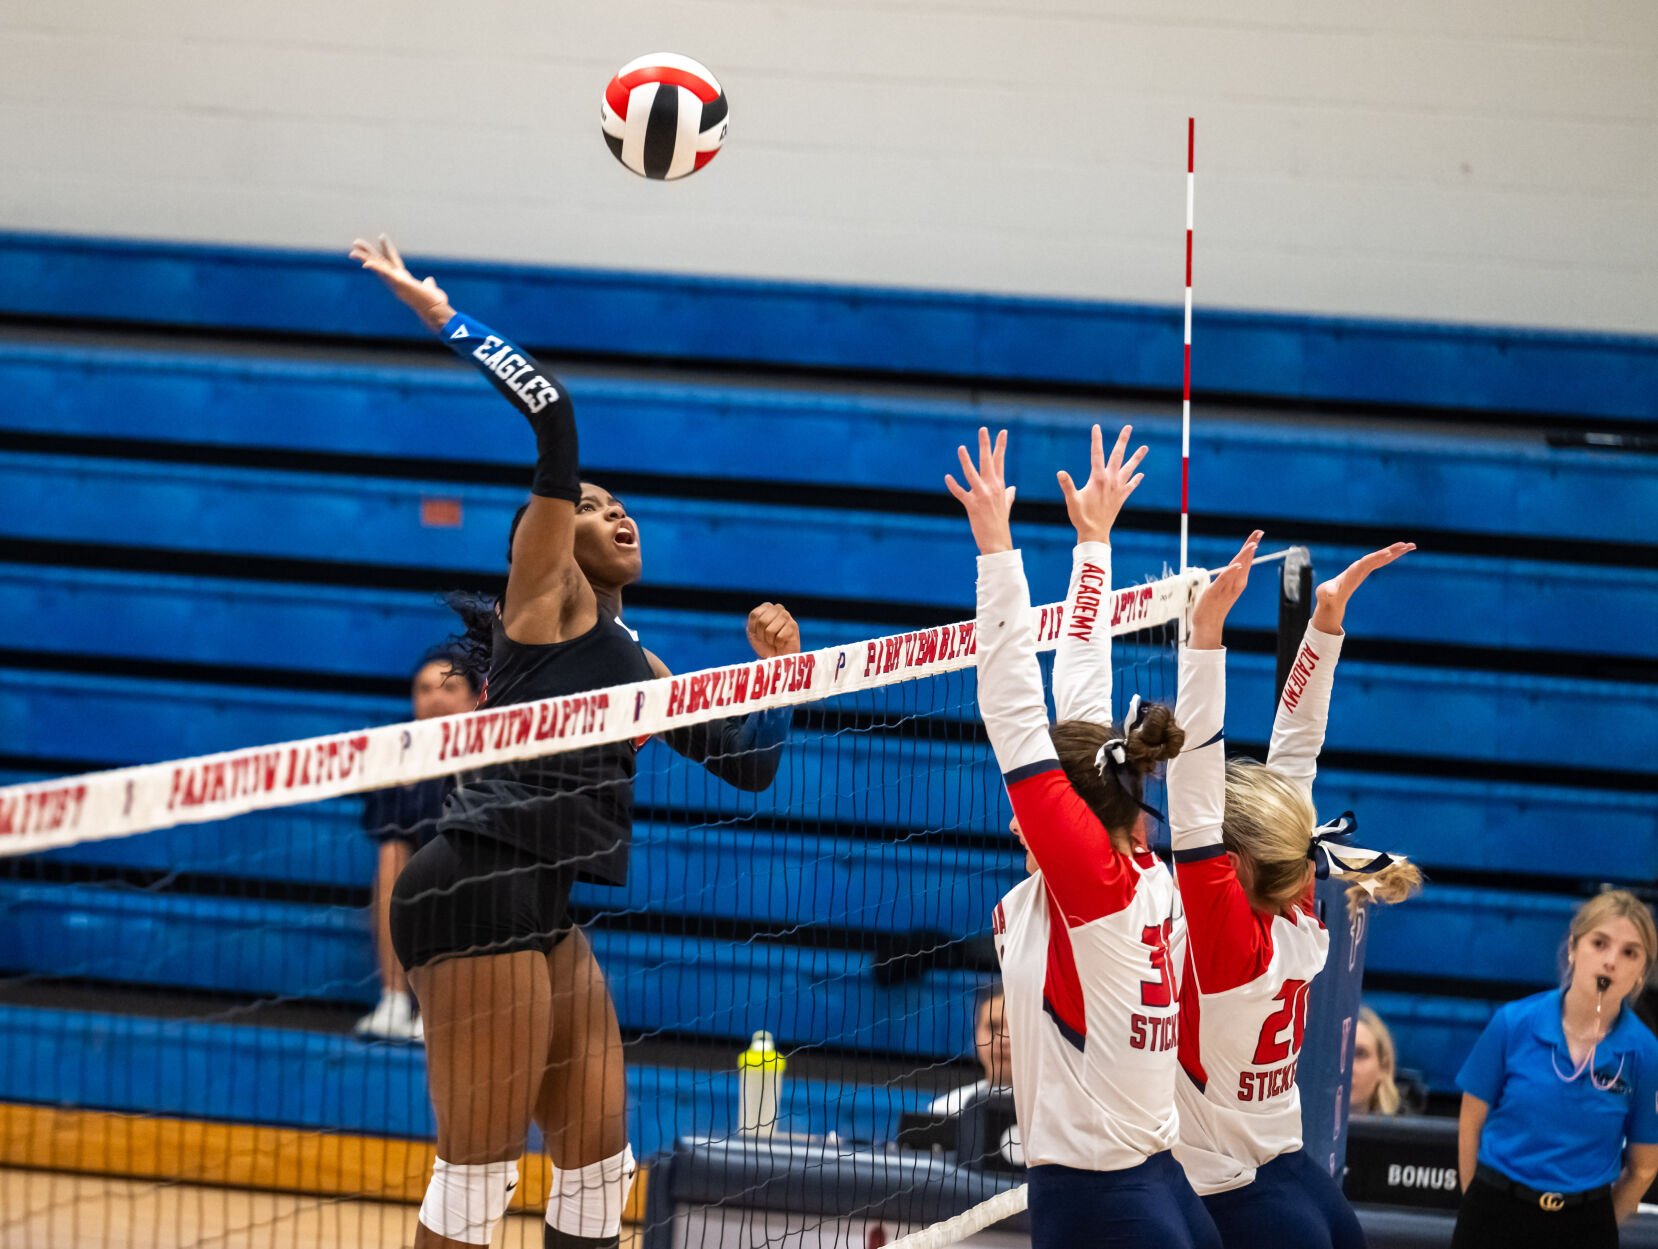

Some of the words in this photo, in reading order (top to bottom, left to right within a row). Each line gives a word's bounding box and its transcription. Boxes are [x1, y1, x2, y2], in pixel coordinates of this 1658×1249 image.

[472, 334, 560, 413] EAGLES
[1067, 562, 1106, 642] ACADEMY
[666, 667, 751, 718] PARKVIEW
[749, 654, 816, 701] BAPTIST
[1281, 641, 1320, 714] ACADEMY
[1387, 1163, 1458, 1191] BONUS
